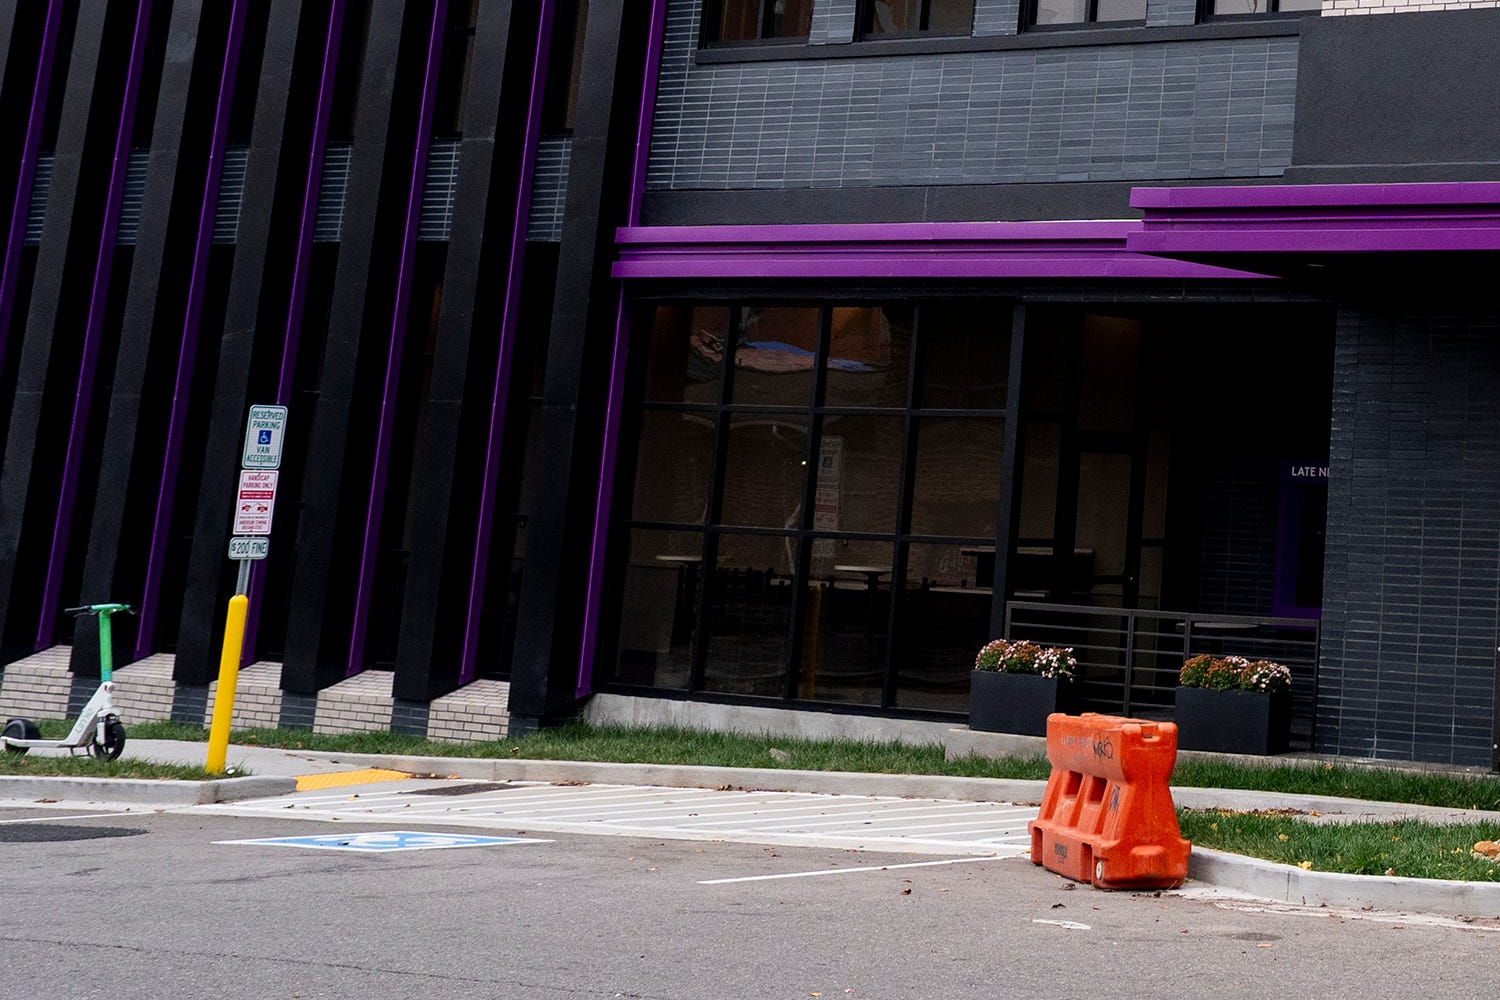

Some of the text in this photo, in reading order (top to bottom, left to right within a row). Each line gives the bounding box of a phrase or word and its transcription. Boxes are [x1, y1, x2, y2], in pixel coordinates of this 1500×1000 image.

[253, 410, 284, 421] RESERVED
[252, 420, 281, 429] PARKING
[246, 454, 278, 463] ACCESSIBLE
[1291, 466, 1316, 477] LATE
[231, 542, 267, 554] $200 FINE
